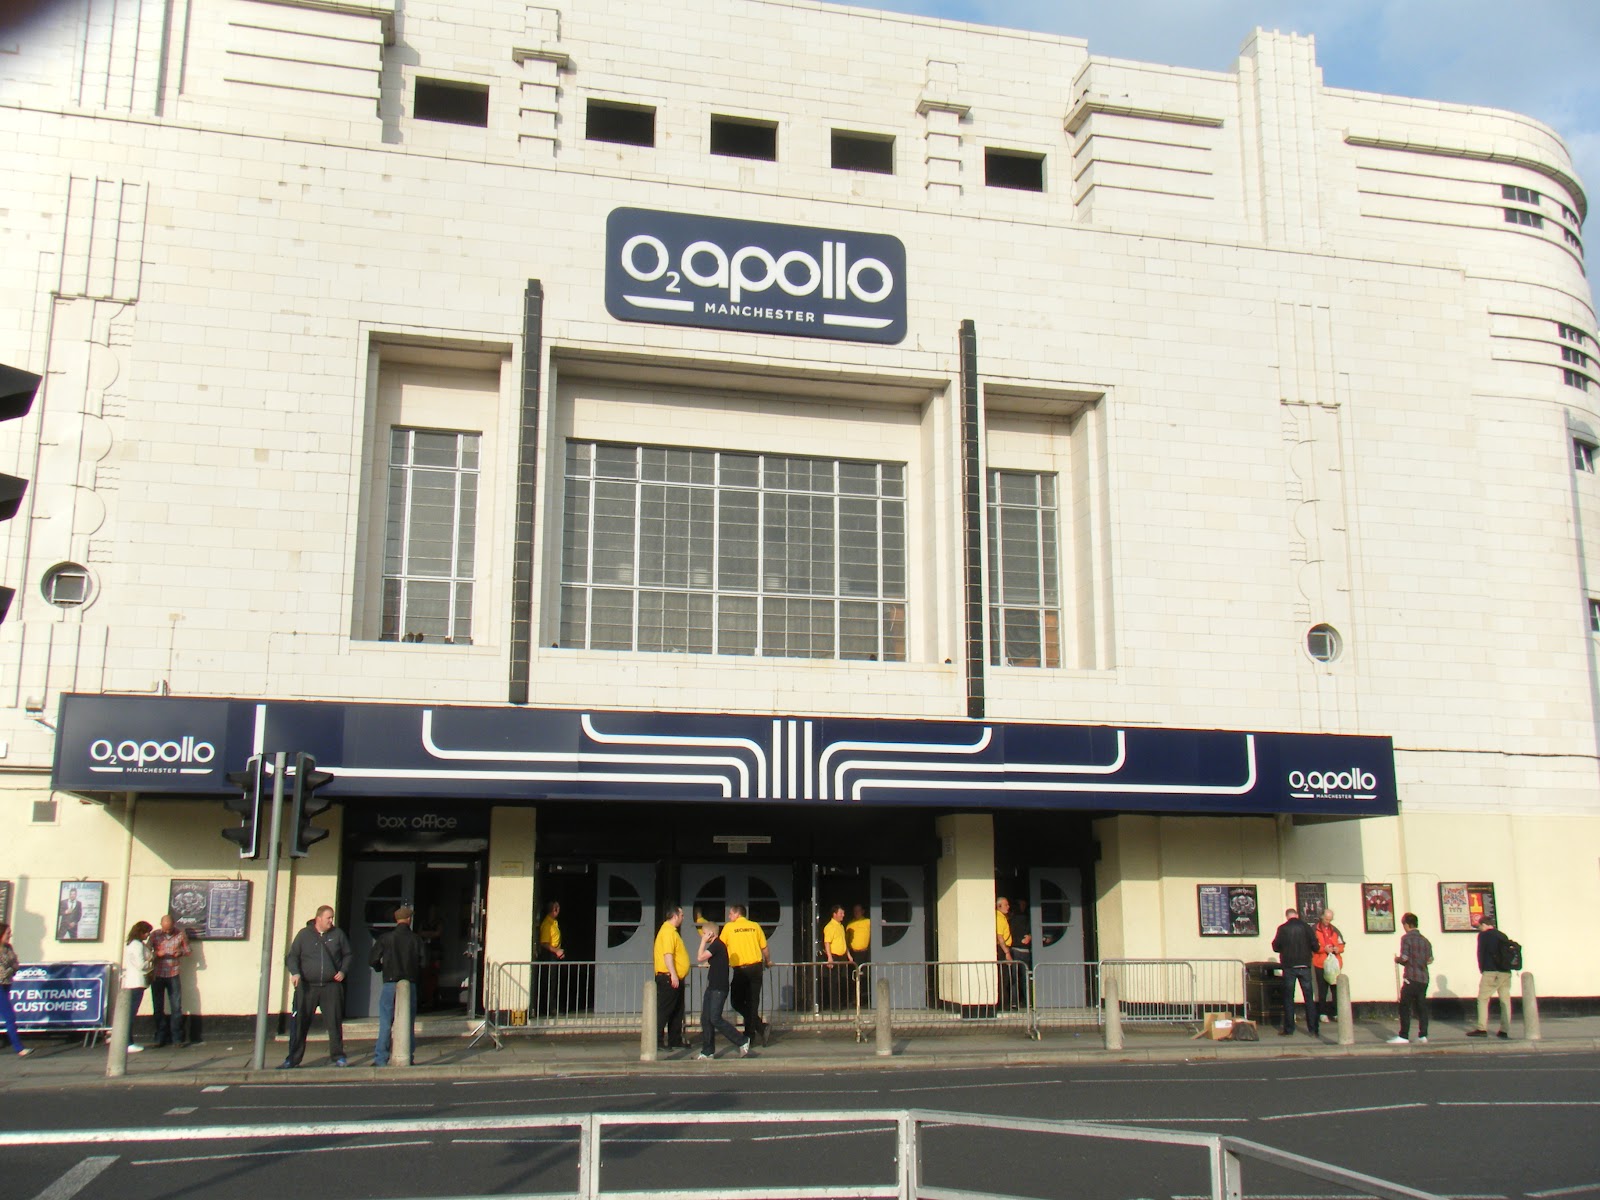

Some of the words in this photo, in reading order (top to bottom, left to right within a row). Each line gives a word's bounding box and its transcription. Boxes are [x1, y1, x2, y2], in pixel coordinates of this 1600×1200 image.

[680, 240, 894, 303] apollo
[704, 302, 816, 323] MANCHESTER
[117, 736, 215, 767] apollo
[1307, 767, 1377, 794] apollo
[377, 814, 406, 828] box
[411, 814, 457, 829] office
[8, 989, 25, 1000] TY
[26, 988, 93, 1000] ENTRANCE
[13, 1000, 88, 1012] CUSTOMERS
